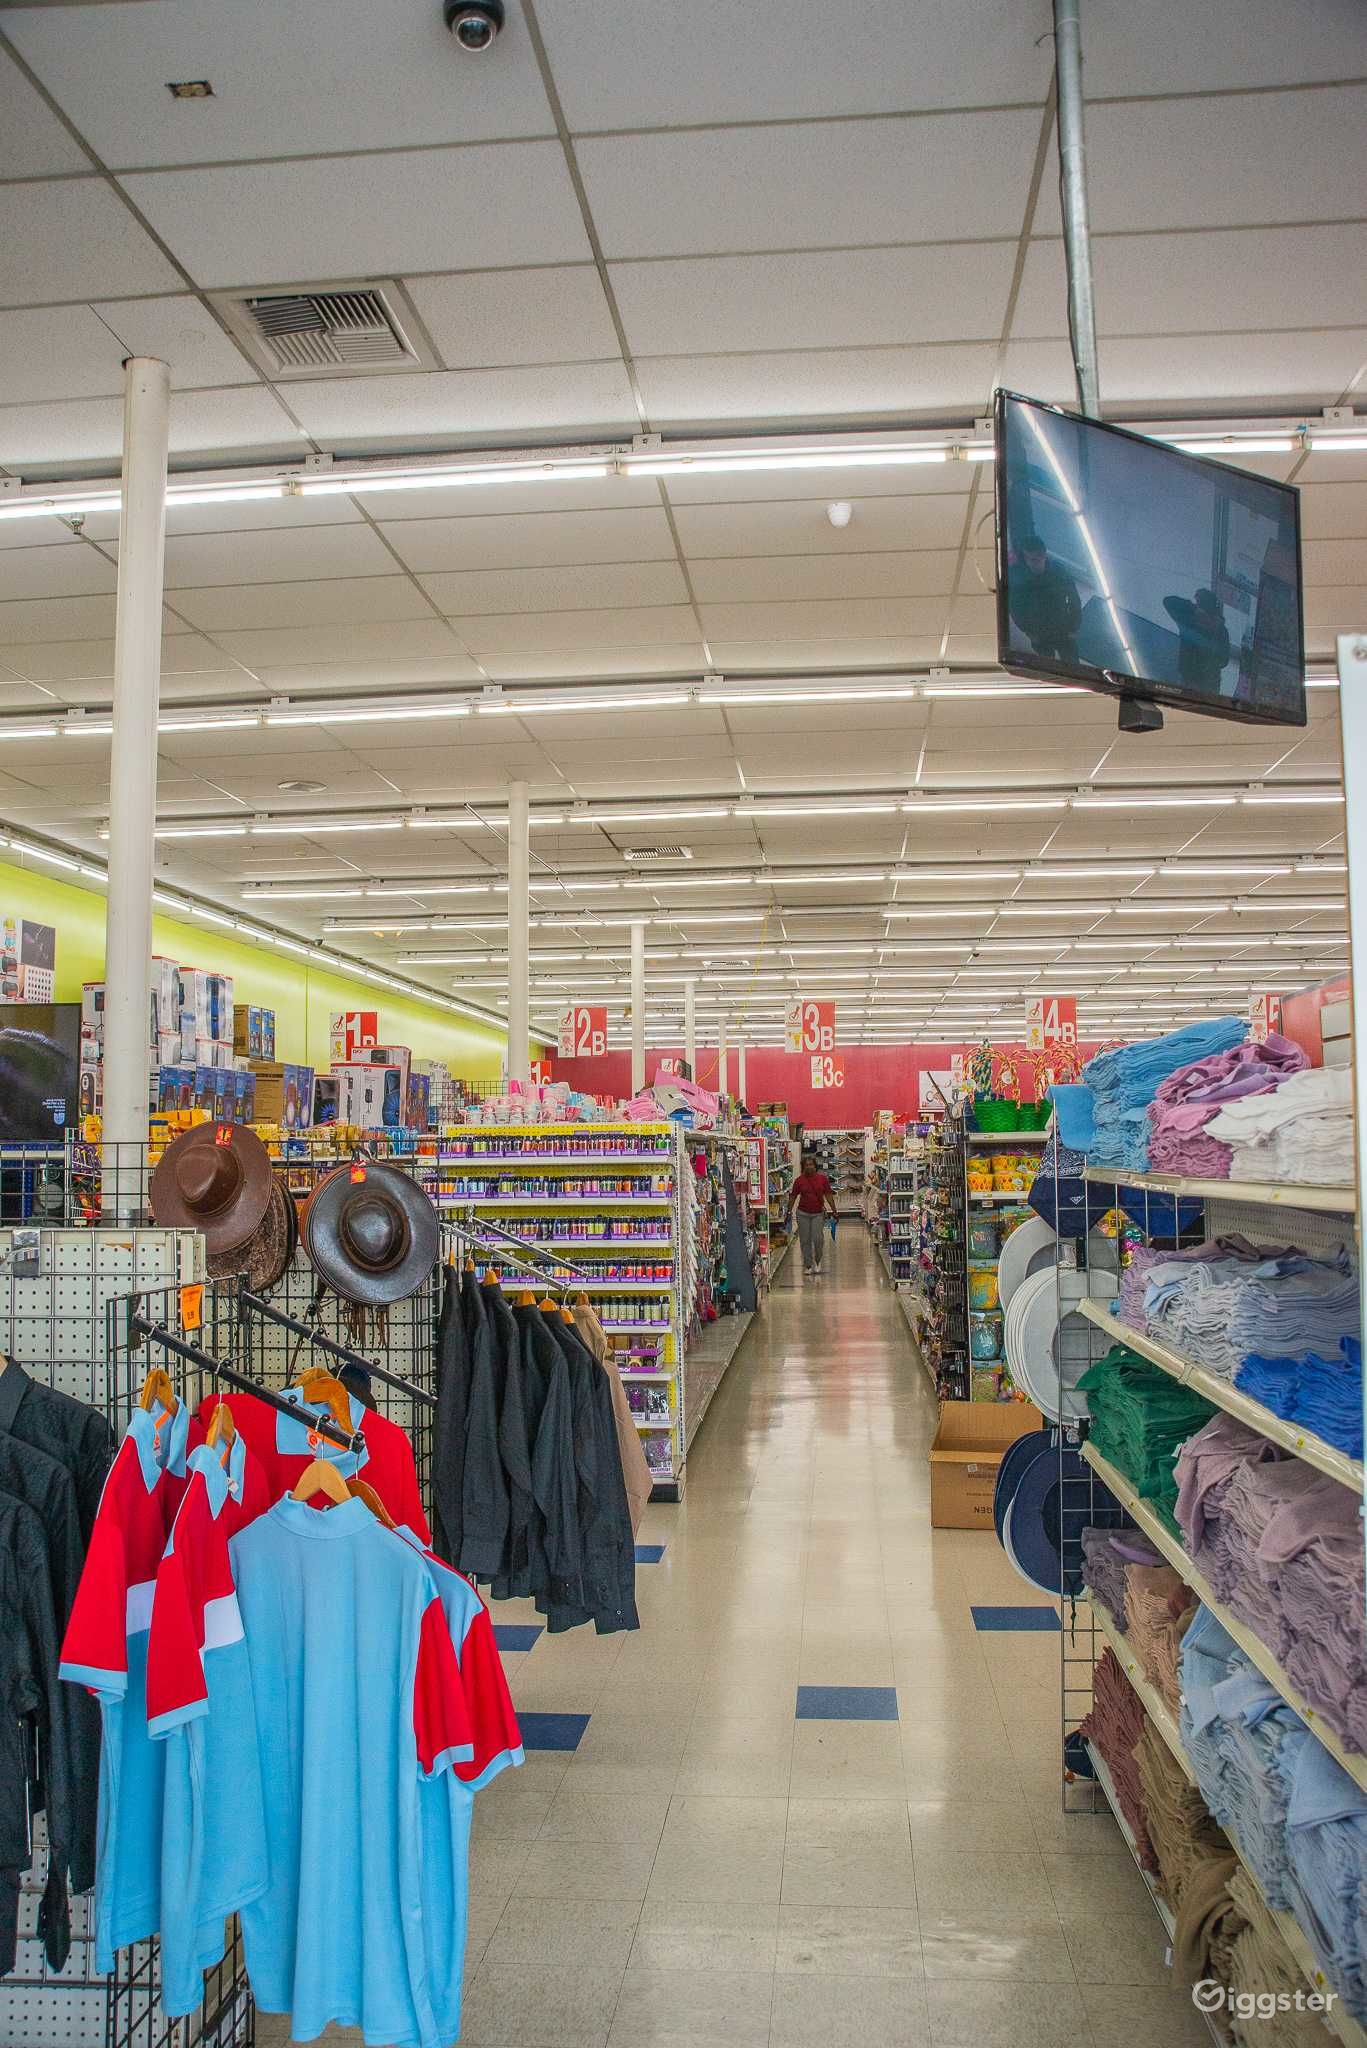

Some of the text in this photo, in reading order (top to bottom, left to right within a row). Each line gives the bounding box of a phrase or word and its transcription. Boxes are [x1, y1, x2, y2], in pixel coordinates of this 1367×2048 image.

[577, 1008, 606, 1057] 2B
[805, 1003, 834, 1052] 3B
[1044, 1000, 1076, 1045] 4B
[823, 1056, 844, 1087] 3C
